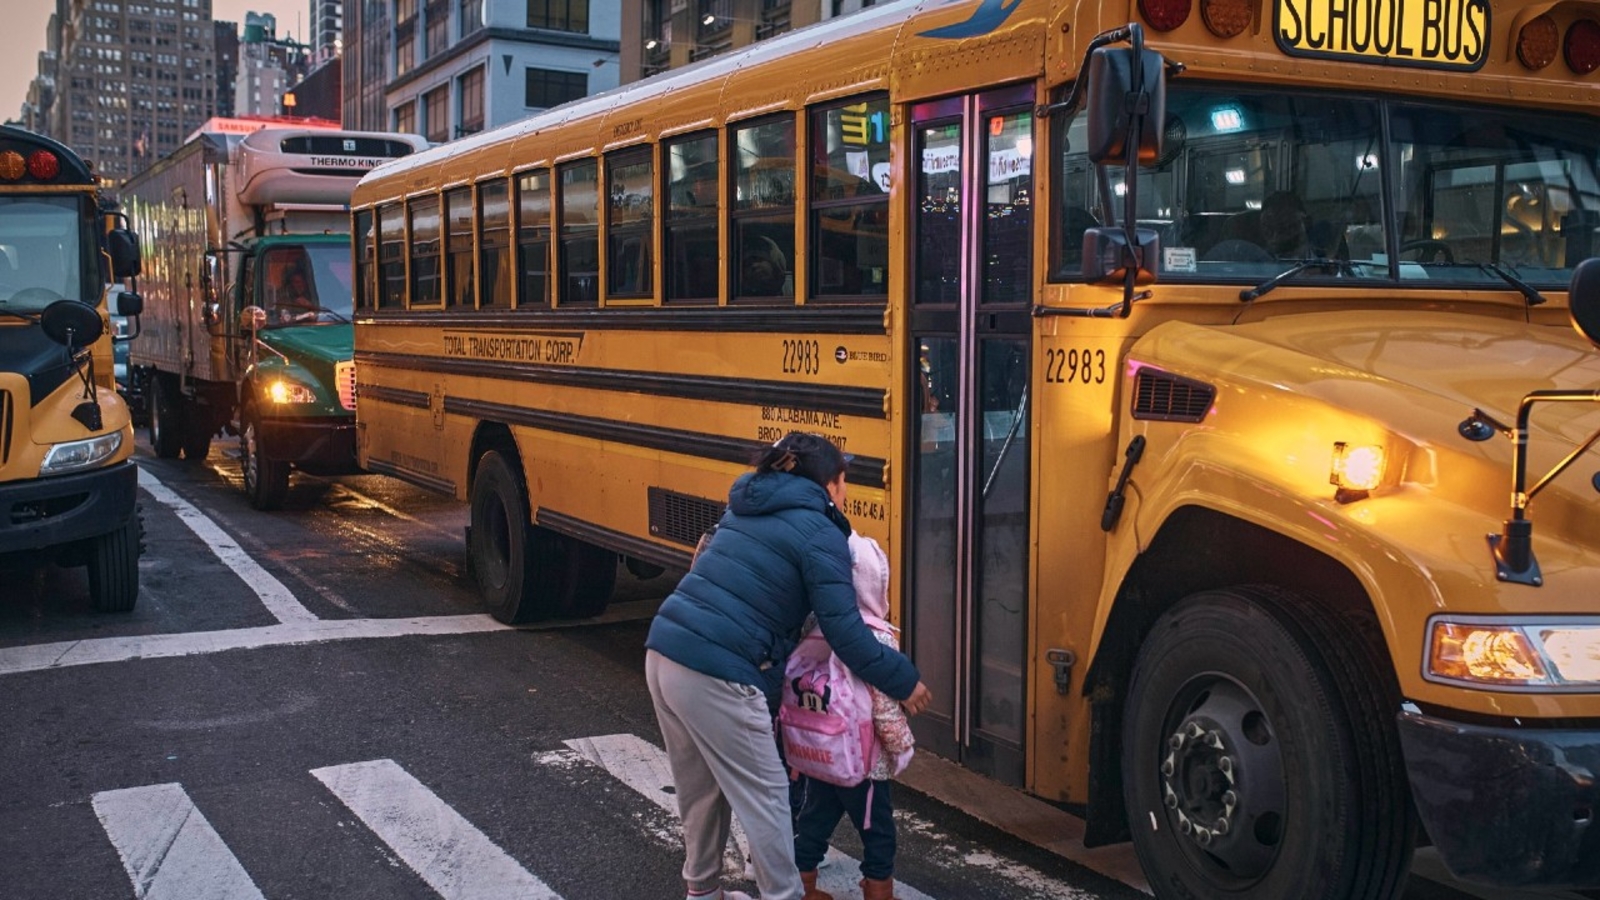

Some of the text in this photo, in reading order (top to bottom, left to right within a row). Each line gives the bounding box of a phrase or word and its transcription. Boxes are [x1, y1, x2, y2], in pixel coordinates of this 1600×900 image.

[1281, 0, 1484, 62] SCHOOL BUS
[311, 156, 382, 168] THERMO KING
[443, 336, 575, 364] TOTAL TRANSPORTATION CORP.
[783, 339, 820, 375] 22983
[849, 351, 887, 362] BLUE BIRD
[1045, 348, 1106, 384] 22983
[777, 407, 820, 426] ALABAMA
[821, 411, 842, 430] AVE.
[788, 742, 834, 765] MINNIE
